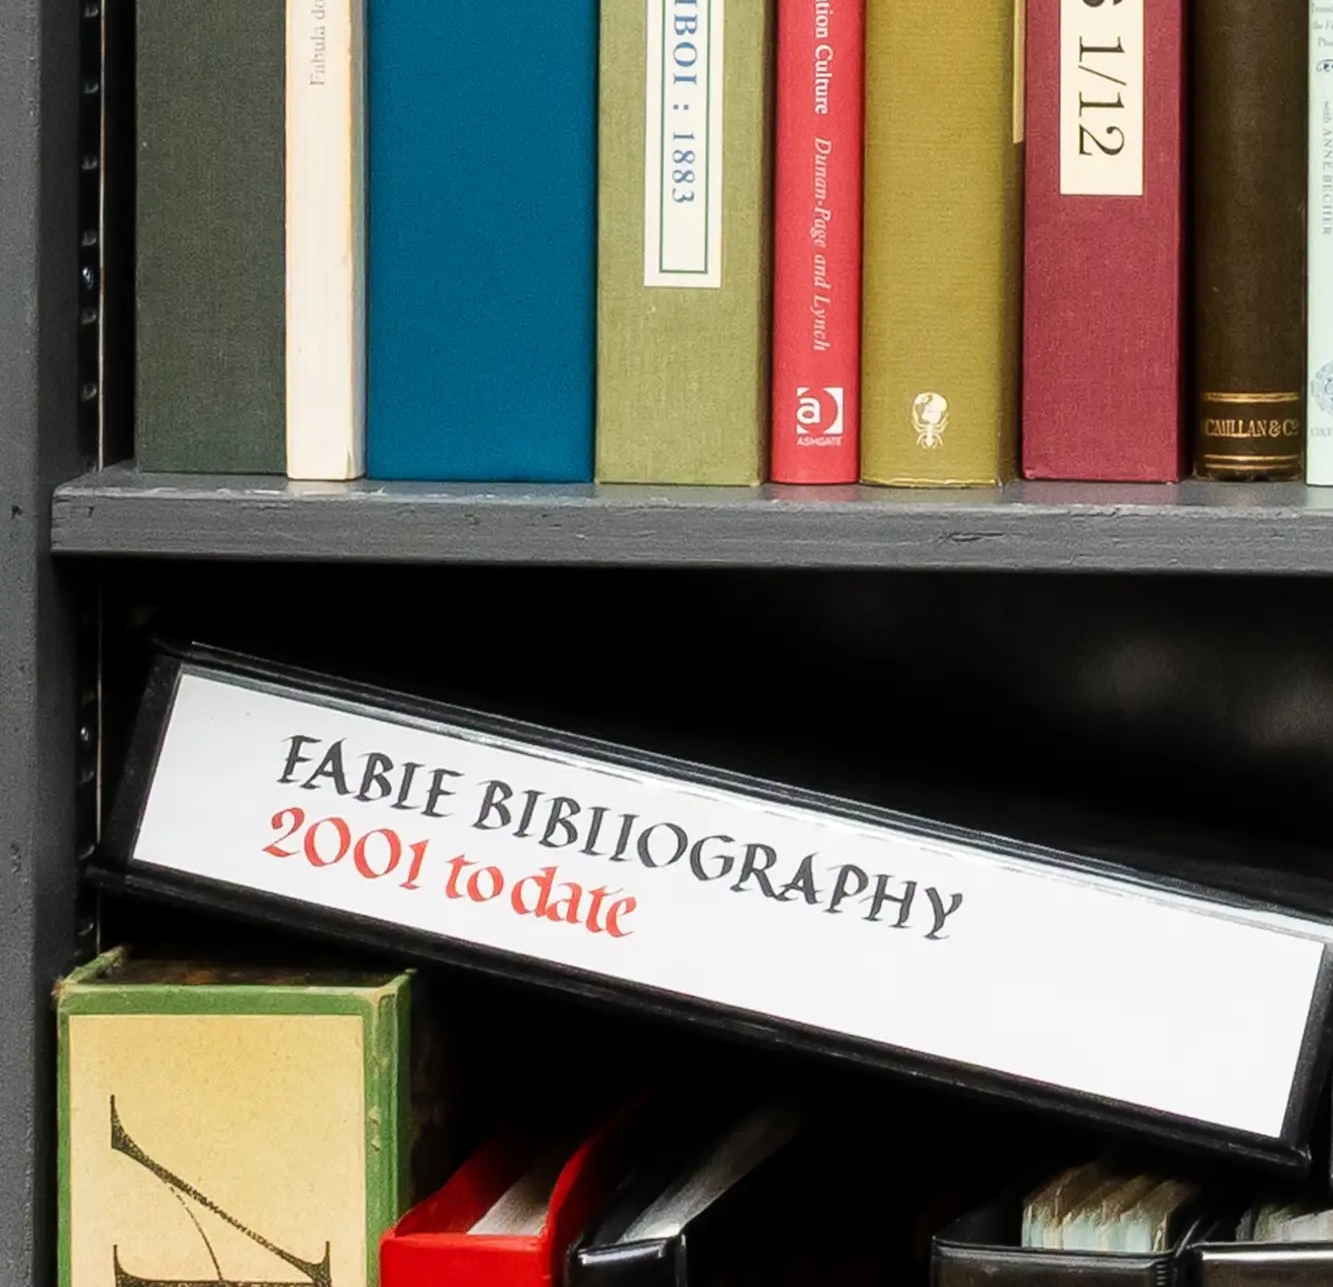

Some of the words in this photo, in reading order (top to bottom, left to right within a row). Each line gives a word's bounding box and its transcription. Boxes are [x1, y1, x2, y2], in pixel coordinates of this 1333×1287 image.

[815, 45, 833, 114] Culture
[1079, 37, 1126, 155] 1/12
[277, 735, 463, 821] FABLE
[471, 782, 963, 942] BIBLIOGRAPHY
